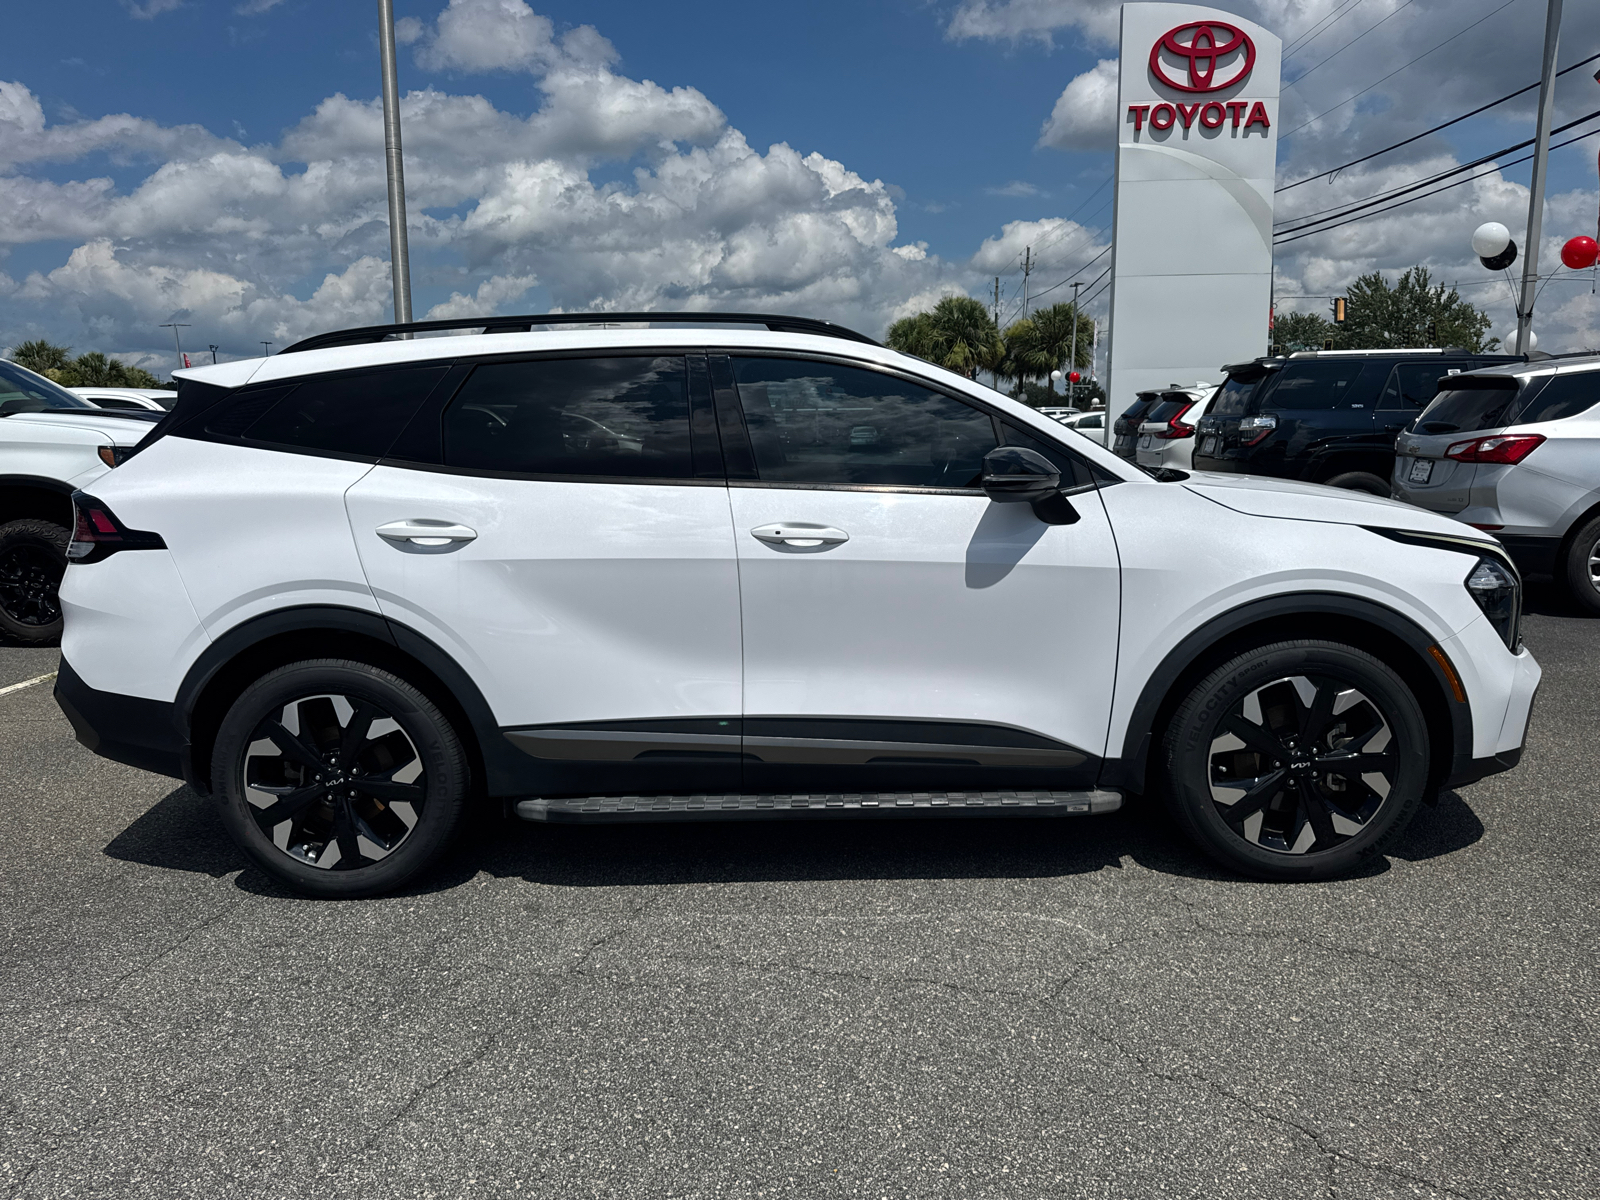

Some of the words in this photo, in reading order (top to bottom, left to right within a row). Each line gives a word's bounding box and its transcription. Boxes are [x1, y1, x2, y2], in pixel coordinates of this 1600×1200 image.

[1128, 101, 1270, 131] TOYOTA
[1185, 675, 1239, 753] VELOCITY
[1238, 659, 1269, 678] SPORT
[428, 739, 449, 824] VELOCITY
[1356, 799, 1414, 860] OMNIMAX
